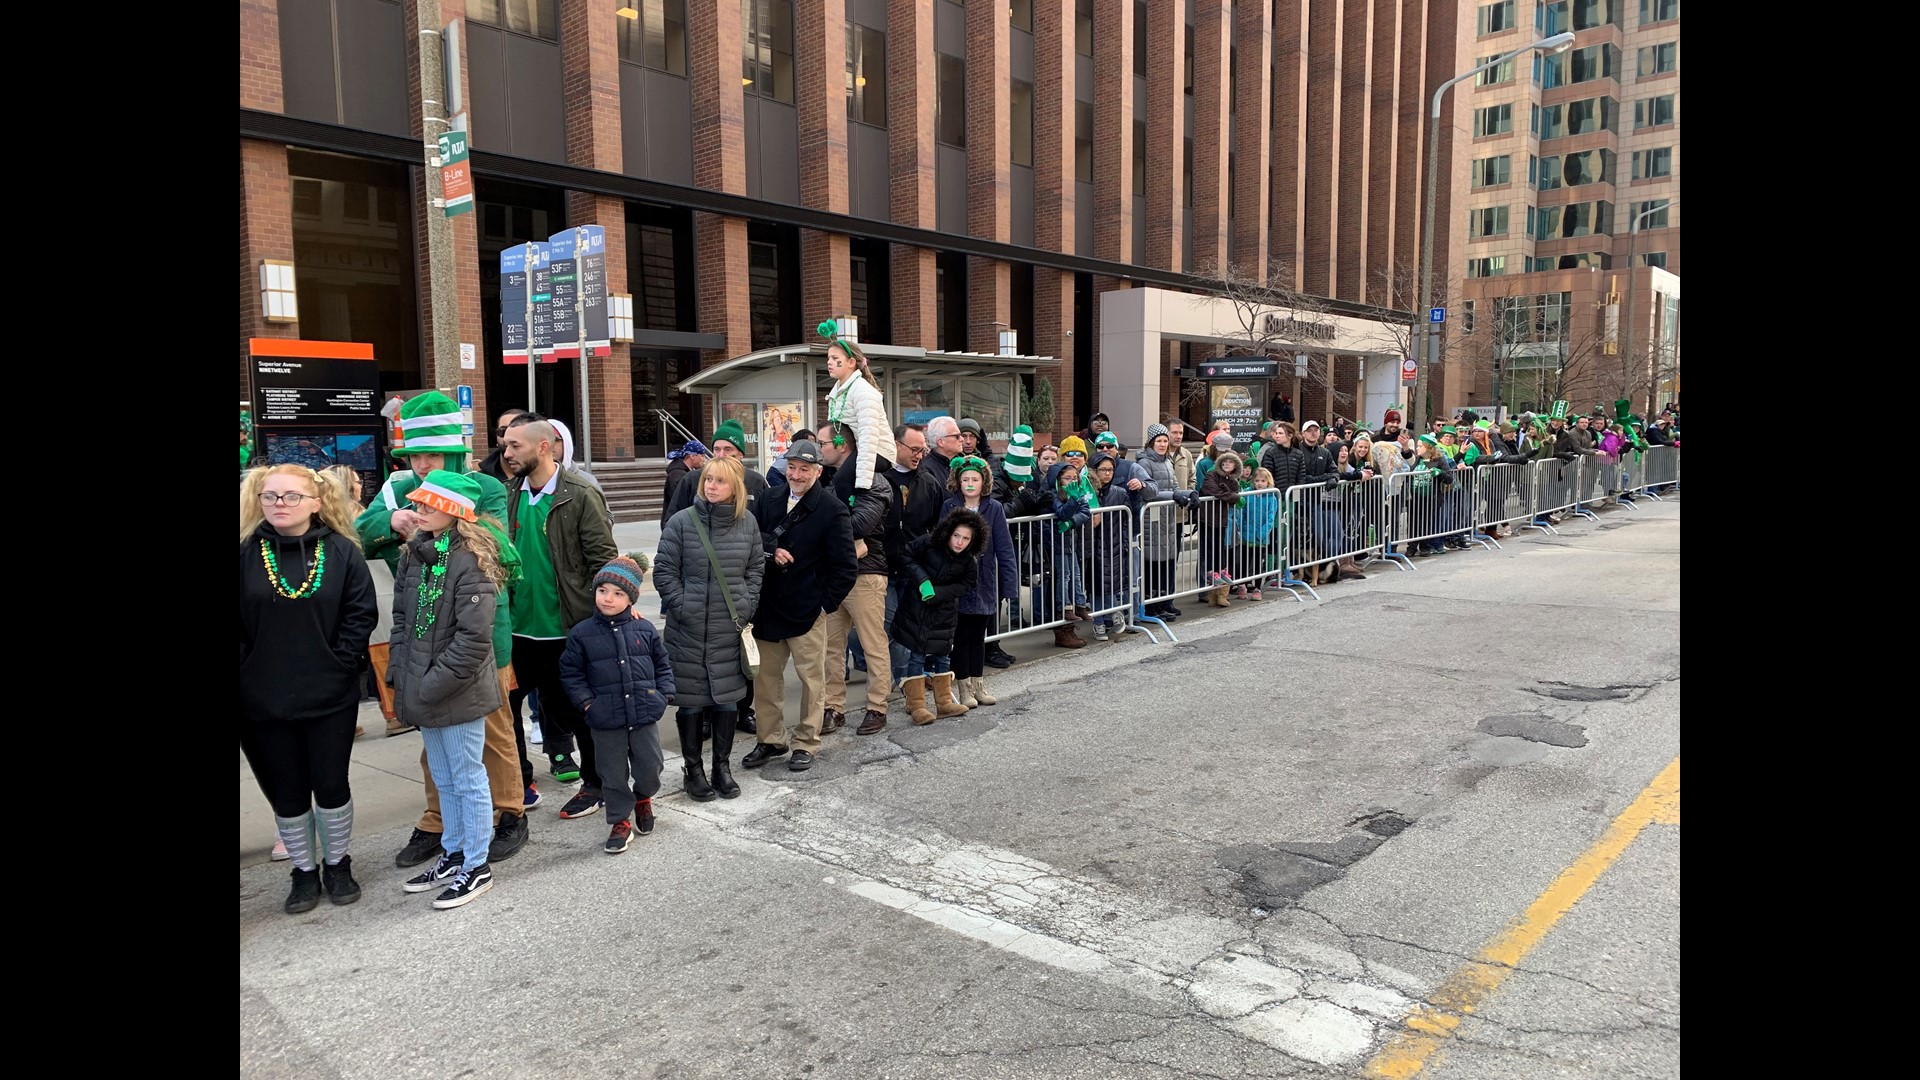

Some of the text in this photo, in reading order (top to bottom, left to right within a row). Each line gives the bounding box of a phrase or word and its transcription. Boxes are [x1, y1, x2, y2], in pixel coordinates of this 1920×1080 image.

[451, 140, 465, 155] RTA
[444, 168, 464, 182] B-Line
[551, 263, 563, 274] 53F
[587, 258, 593, 269] 76
[510, 275, 514, 285] 3
[536, 282, 543, 292] 45
[556, 284, 564, 295] 55
[585, 283, 594, 295] 251
[553, 297, 565, 308] 55A
[586, 296, 595, 307] 263
[537, 303, 543, 313] 51
[534, 315, 544, 324] 51A
[553, 309, 565, 320] 55B
[507, 324, 515, 334] 22
[535, 325, 544, 335] 51B
[554, 322, 565, 332] 55C
[508, 335, 516, 344] 26
[534, 336, 545, 346] 51C
[258, 360, 282, 368] Superior
[1212, 408, 1262, 417] SIMULCAST
